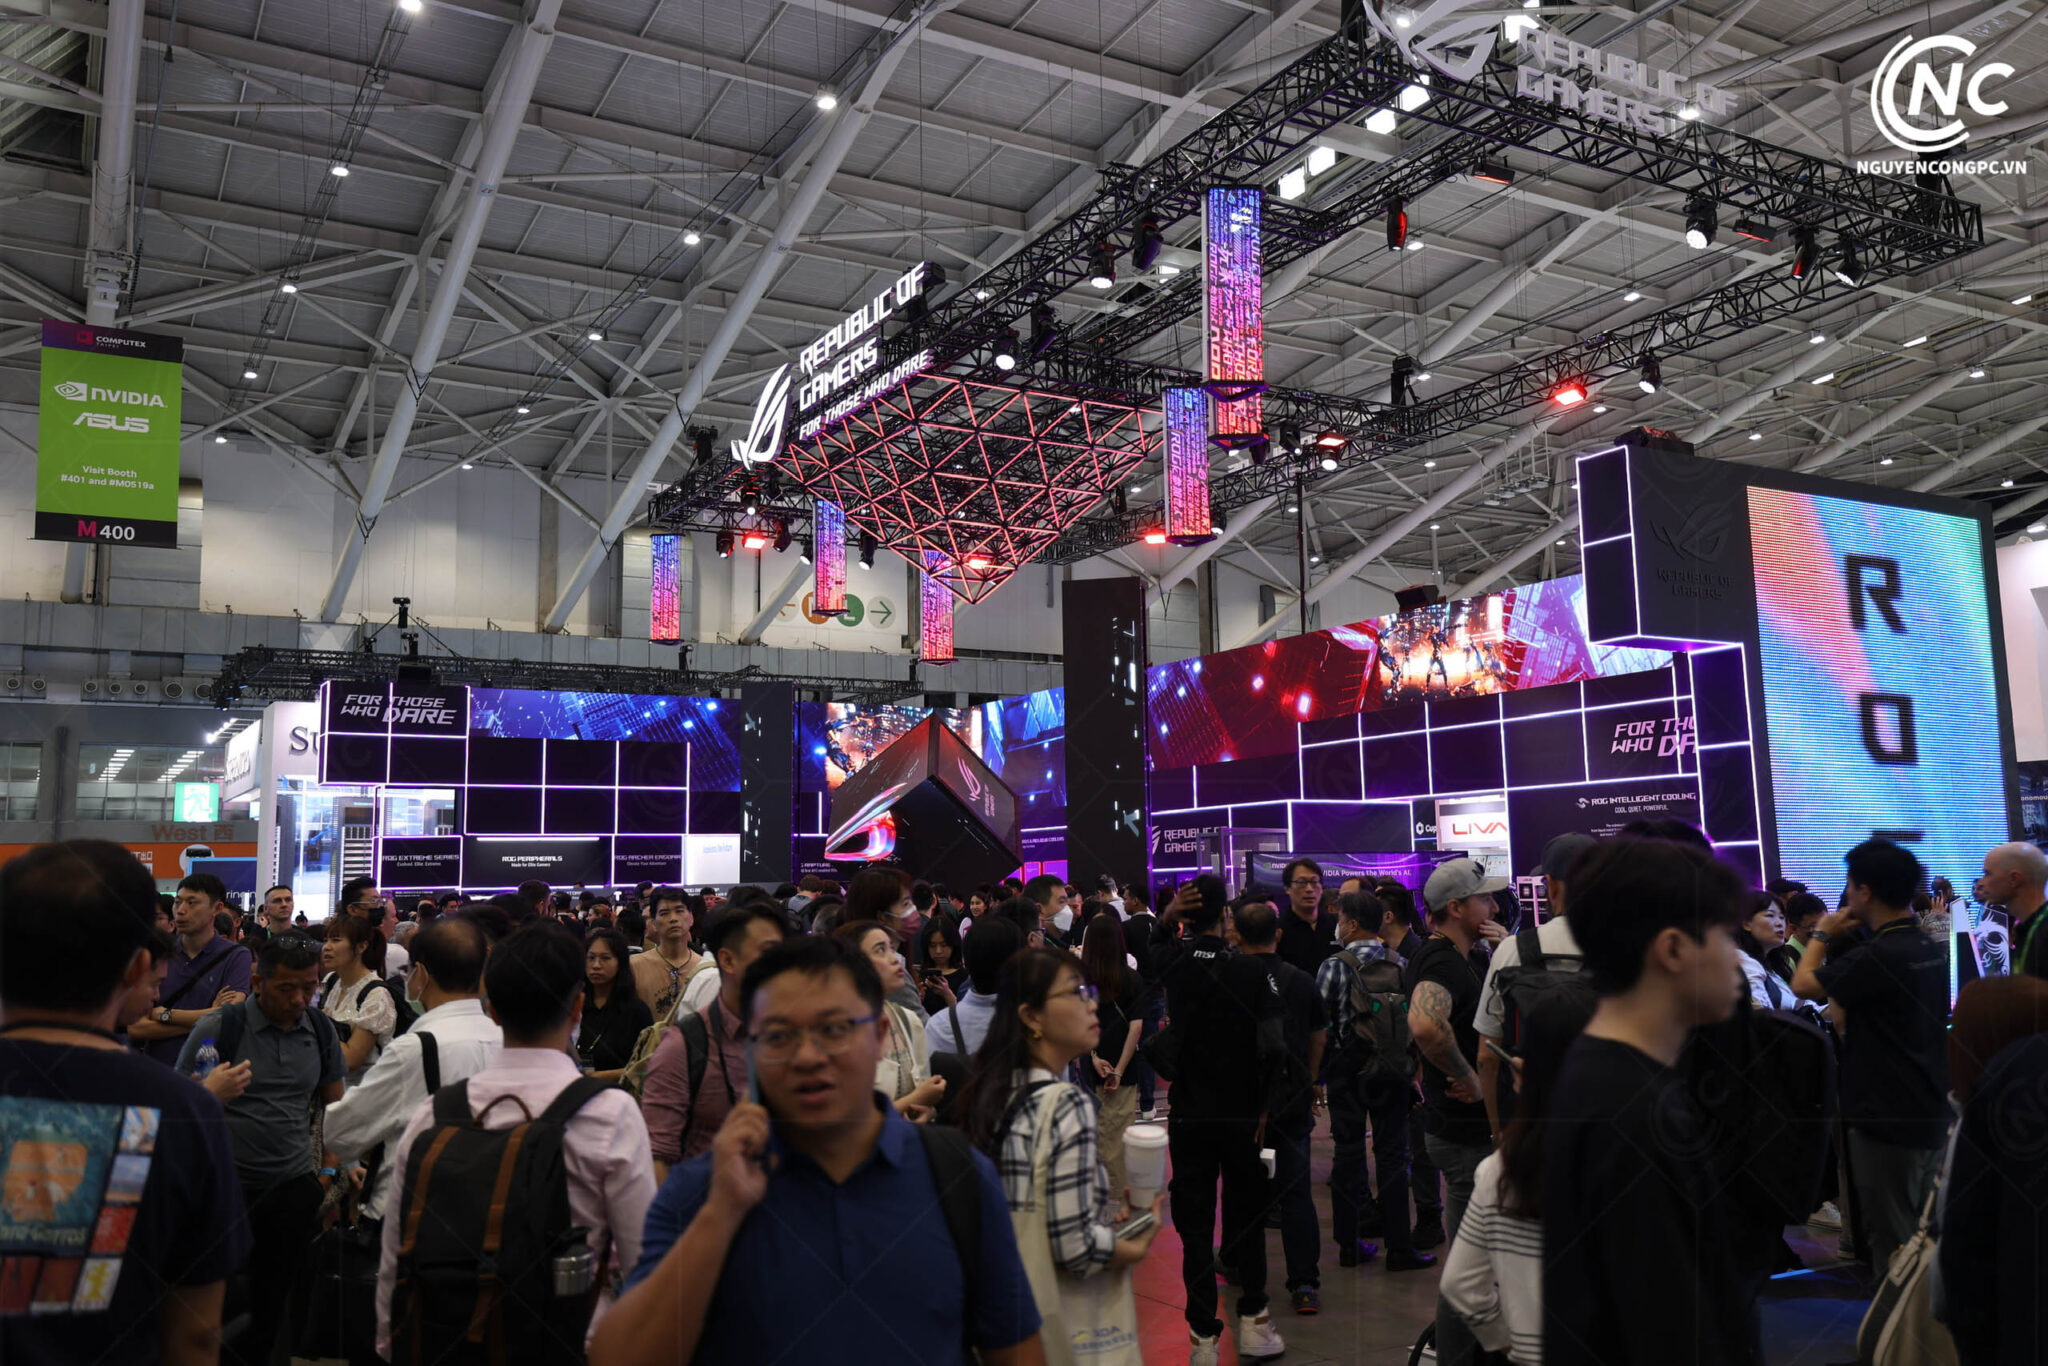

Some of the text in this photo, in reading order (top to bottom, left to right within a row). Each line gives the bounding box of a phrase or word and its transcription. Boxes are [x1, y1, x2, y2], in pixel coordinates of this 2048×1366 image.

[1518, 25, 1738, 116] REPUBLIC OF
[1517, 65, 1665, 134] GAMERS
[800, 261, 925, 376] REPUBLIC OF
[96, 336, 146, 348] COMPUTEX
[800, 337, 877, 412] GAMERS
[91, 387, 166, 408] NVIDIA
[799, 349, 930, 440] FOR THOSE WHO DARE
[72, 412, 150, 433] ASUS
[82, 465, 137, 478] Visit Booth
[61, 473, 155, 490] #401 and #M0519a
[77, 520, 135, 541] M 400
[345, 694, 446, 708] FOR THOSE
[340, 705, 457, 724] WHO DARE
[1614, 720, 1656, 738] FOR
[1610, 736, 1654, 754] WHO
[1591, 793, 1696, 806] ROG INTELLIGENT COOLING
[151, 824, 206, 840] West
[214, 824, 234, 840] 西
[1341, 869, 1365, 877] Powers
[1193, 949, 1216, 959] msi
